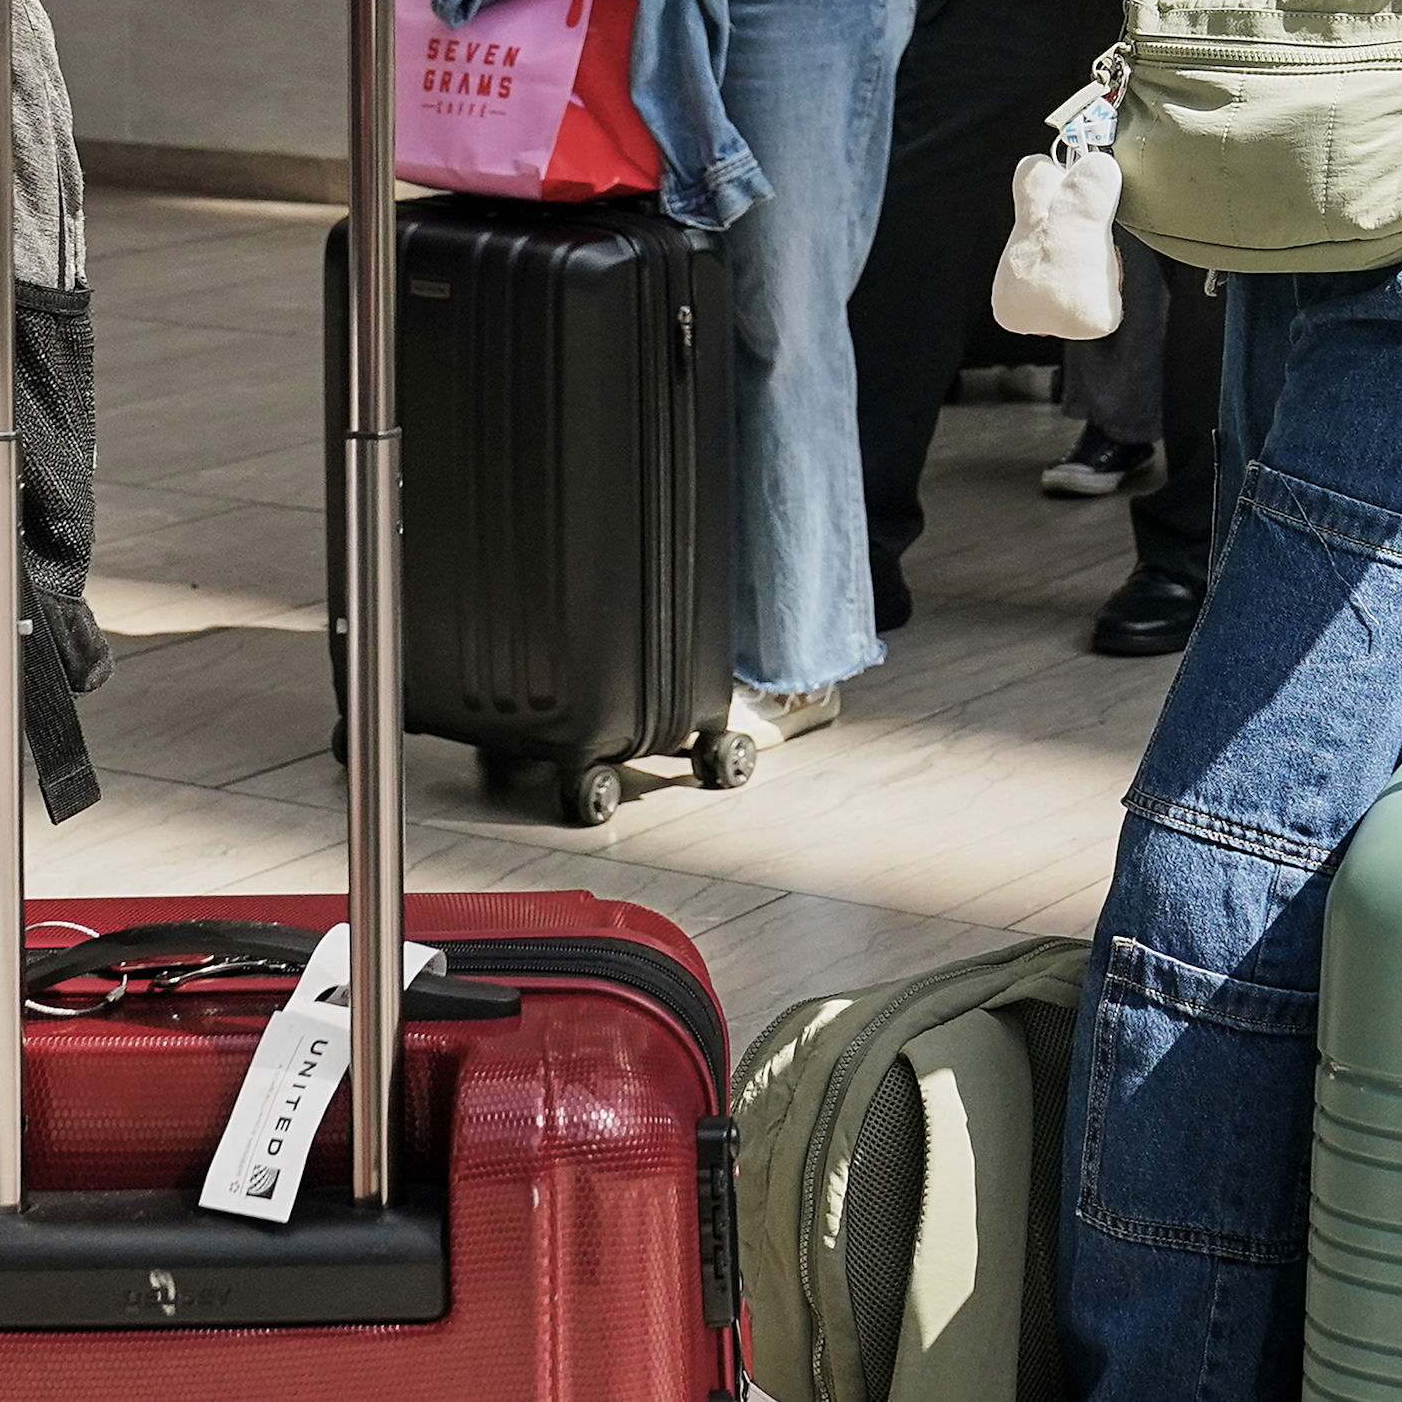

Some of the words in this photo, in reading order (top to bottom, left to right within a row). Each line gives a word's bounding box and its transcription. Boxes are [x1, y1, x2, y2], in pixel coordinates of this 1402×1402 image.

[426, 38, 521, 67] SEVEN
[422, 69, 513, 99] GRAMS
[267, 1039, 329, 1157] UNITED
